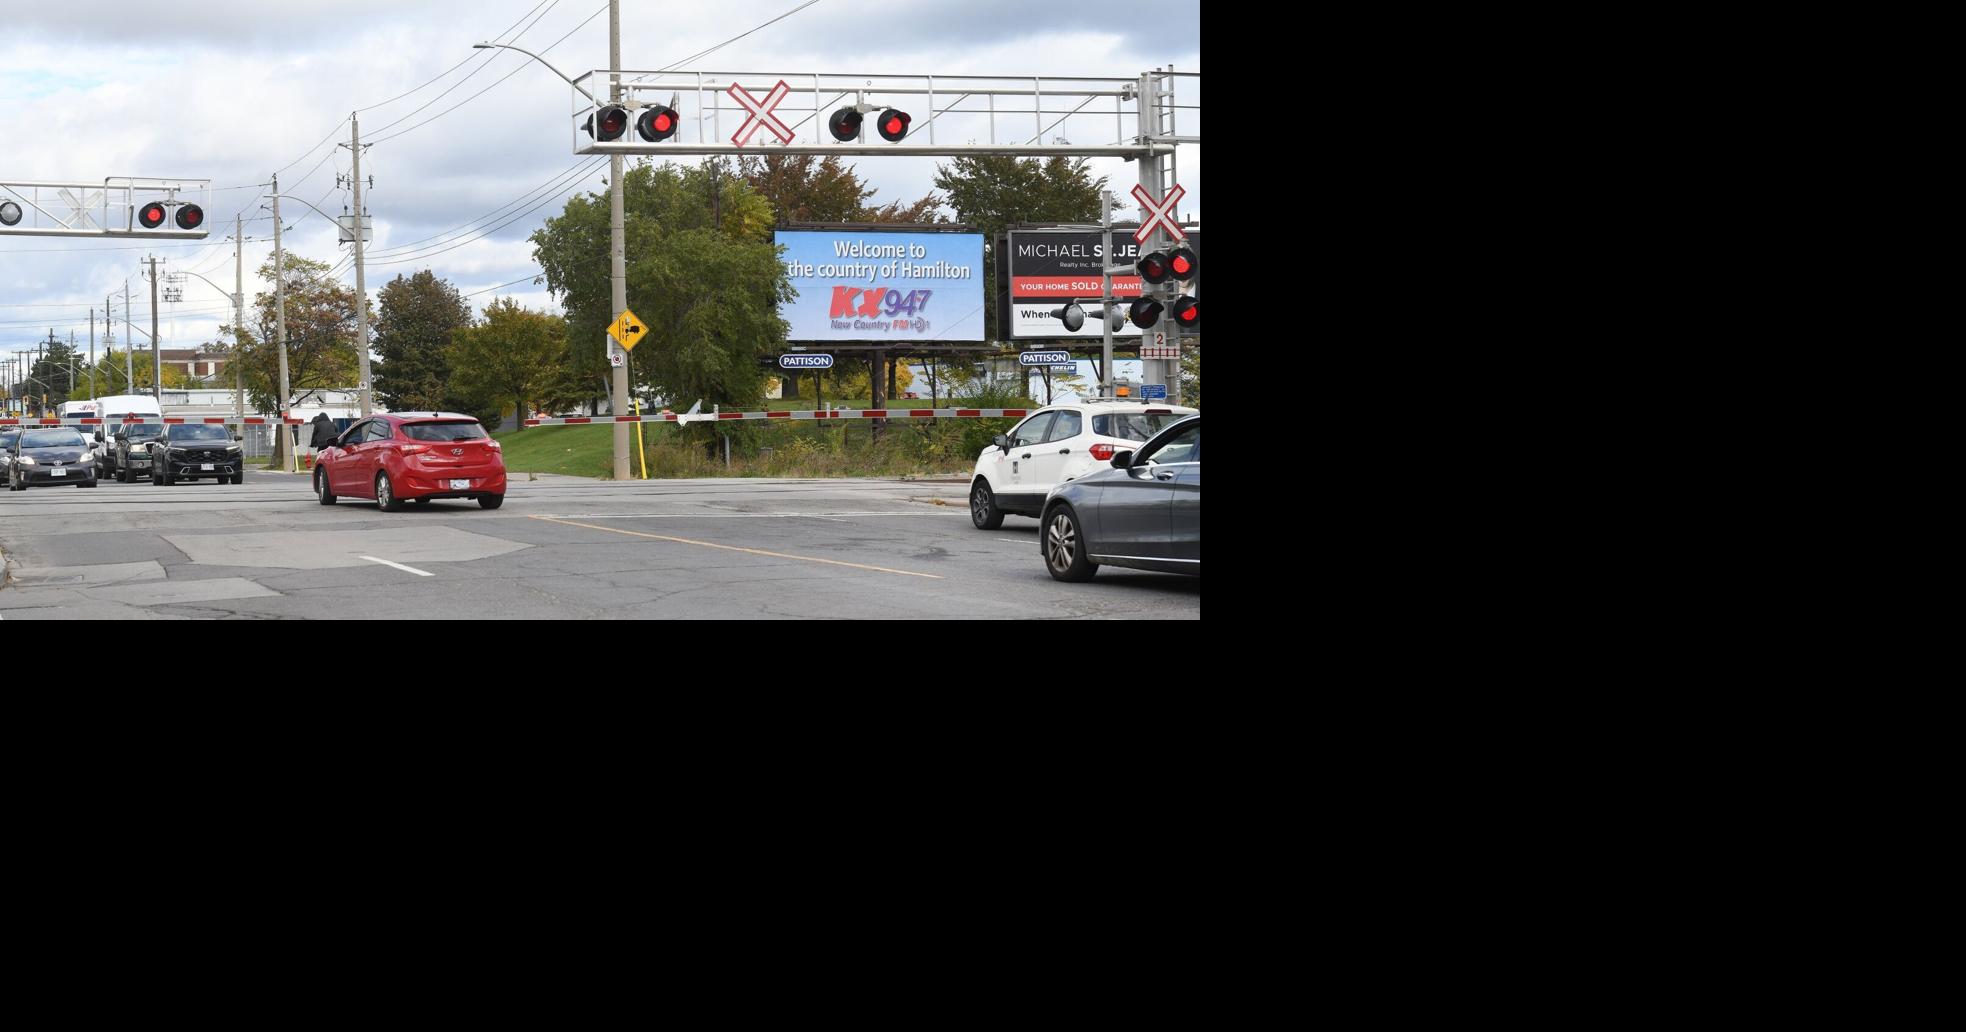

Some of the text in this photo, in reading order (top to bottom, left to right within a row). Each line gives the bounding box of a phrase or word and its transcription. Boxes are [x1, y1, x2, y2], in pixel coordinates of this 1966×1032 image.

[834, 240, 925, 258] Welcome to
[1019, 244, 1142, 257] MICHAEL S.JE
[789, 261, 970, 282] the country of Hamilton
[1072, 282, 1098, 290] SOLD
[854, 320, 890, 332] Country
[1157, 333, 1163, 344] 2
[784, 357, 829, 366] PATTISON
[1024, 354, 1066, 362] PATTISON
